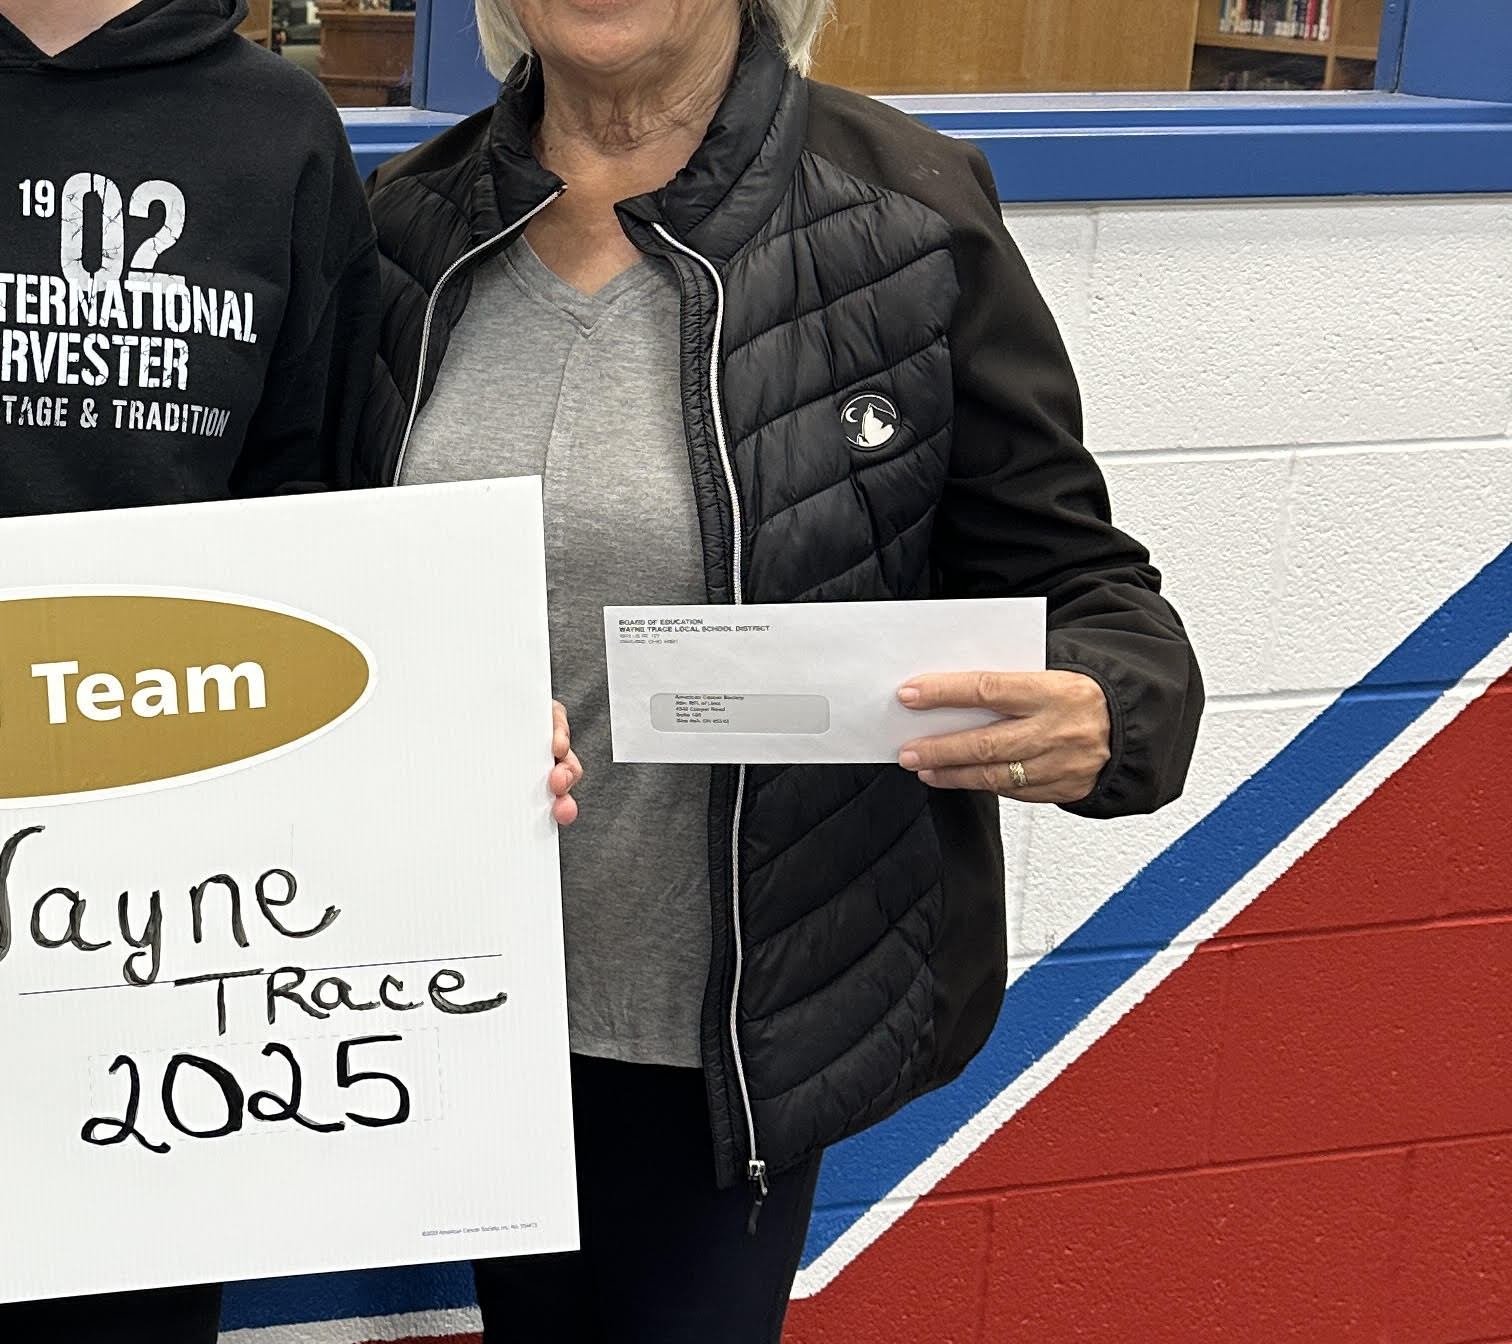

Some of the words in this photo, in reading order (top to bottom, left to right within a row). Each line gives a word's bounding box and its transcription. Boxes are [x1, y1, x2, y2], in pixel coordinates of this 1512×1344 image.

[79, 397, 99, 429] &
[112, 399, 231, 438] TRADITION
[31, 659, 267, 725] Team
[80, 1034, 411, 1154] 2025
